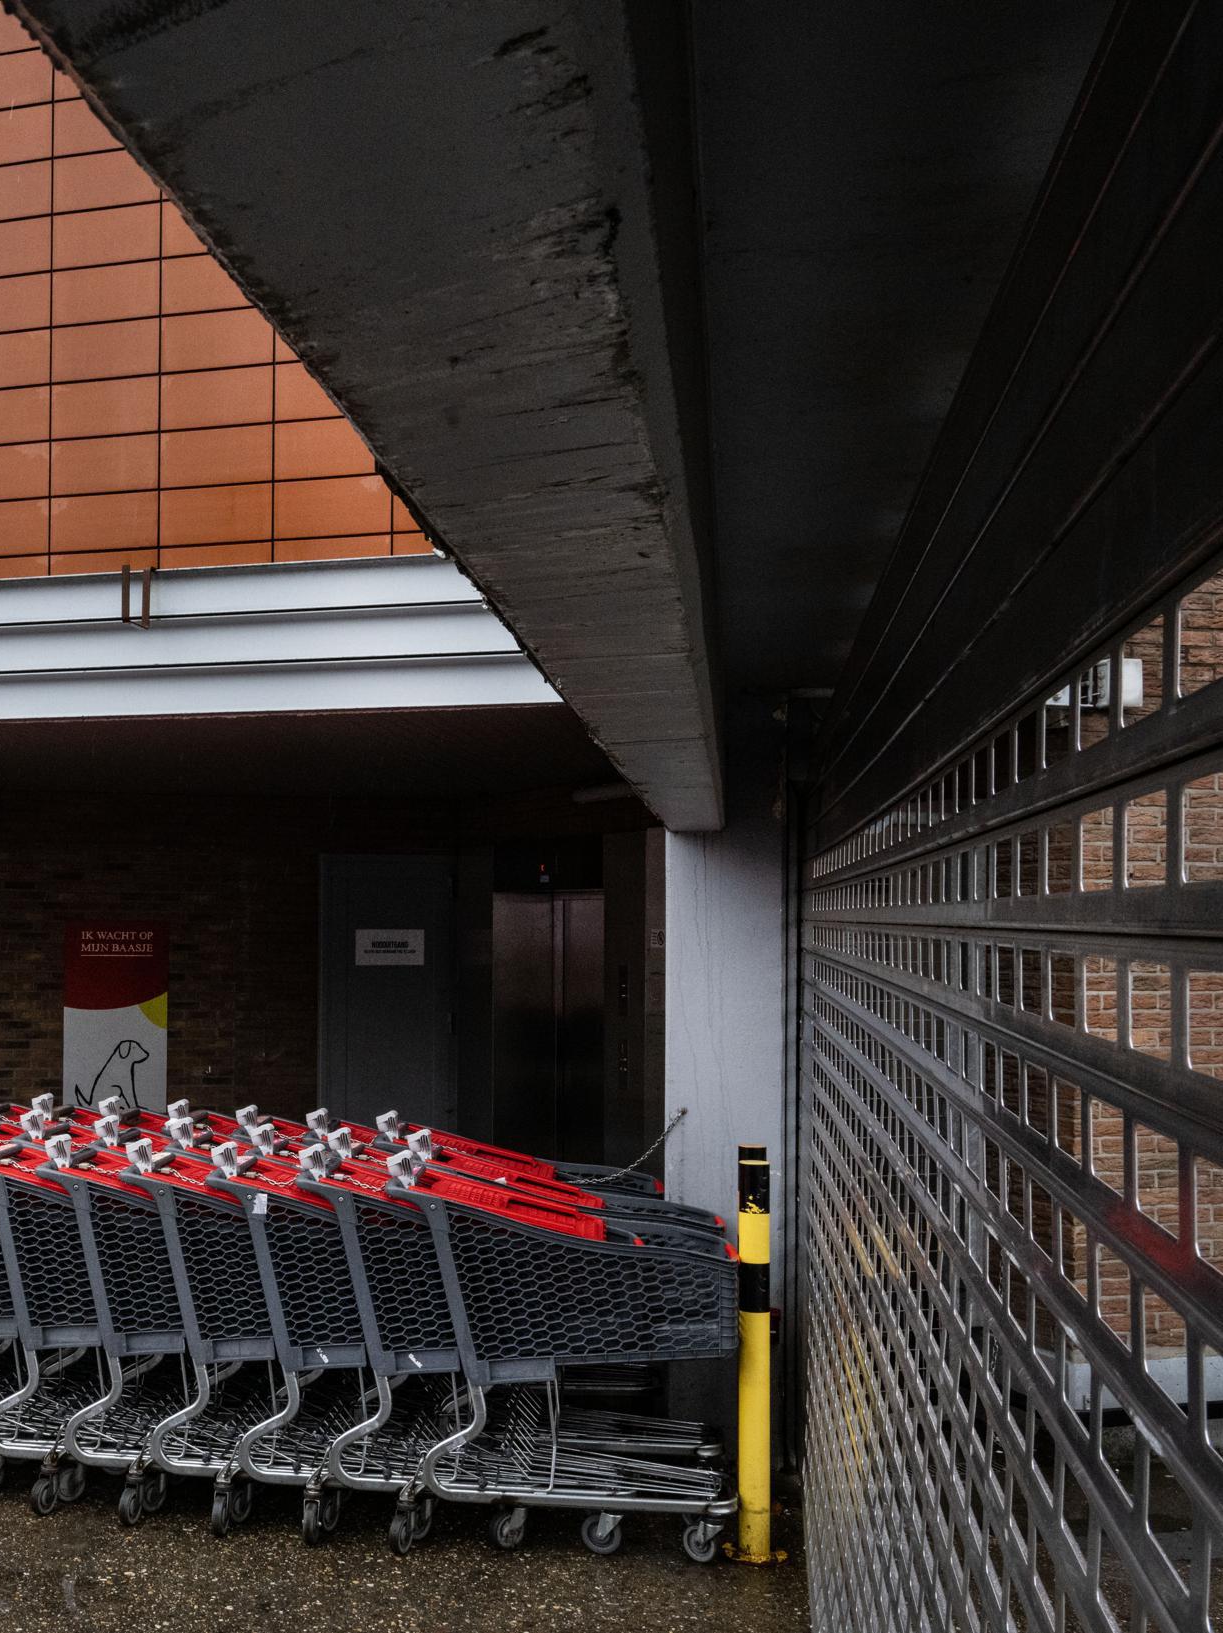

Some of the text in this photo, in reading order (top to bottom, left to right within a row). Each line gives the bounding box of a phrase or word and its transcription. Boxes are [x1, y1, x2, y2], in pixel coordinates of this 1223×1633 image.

[81, 931, 154, 940] IK WACHT OP
[80, 943, 154, 952] MIJN BAASJE
